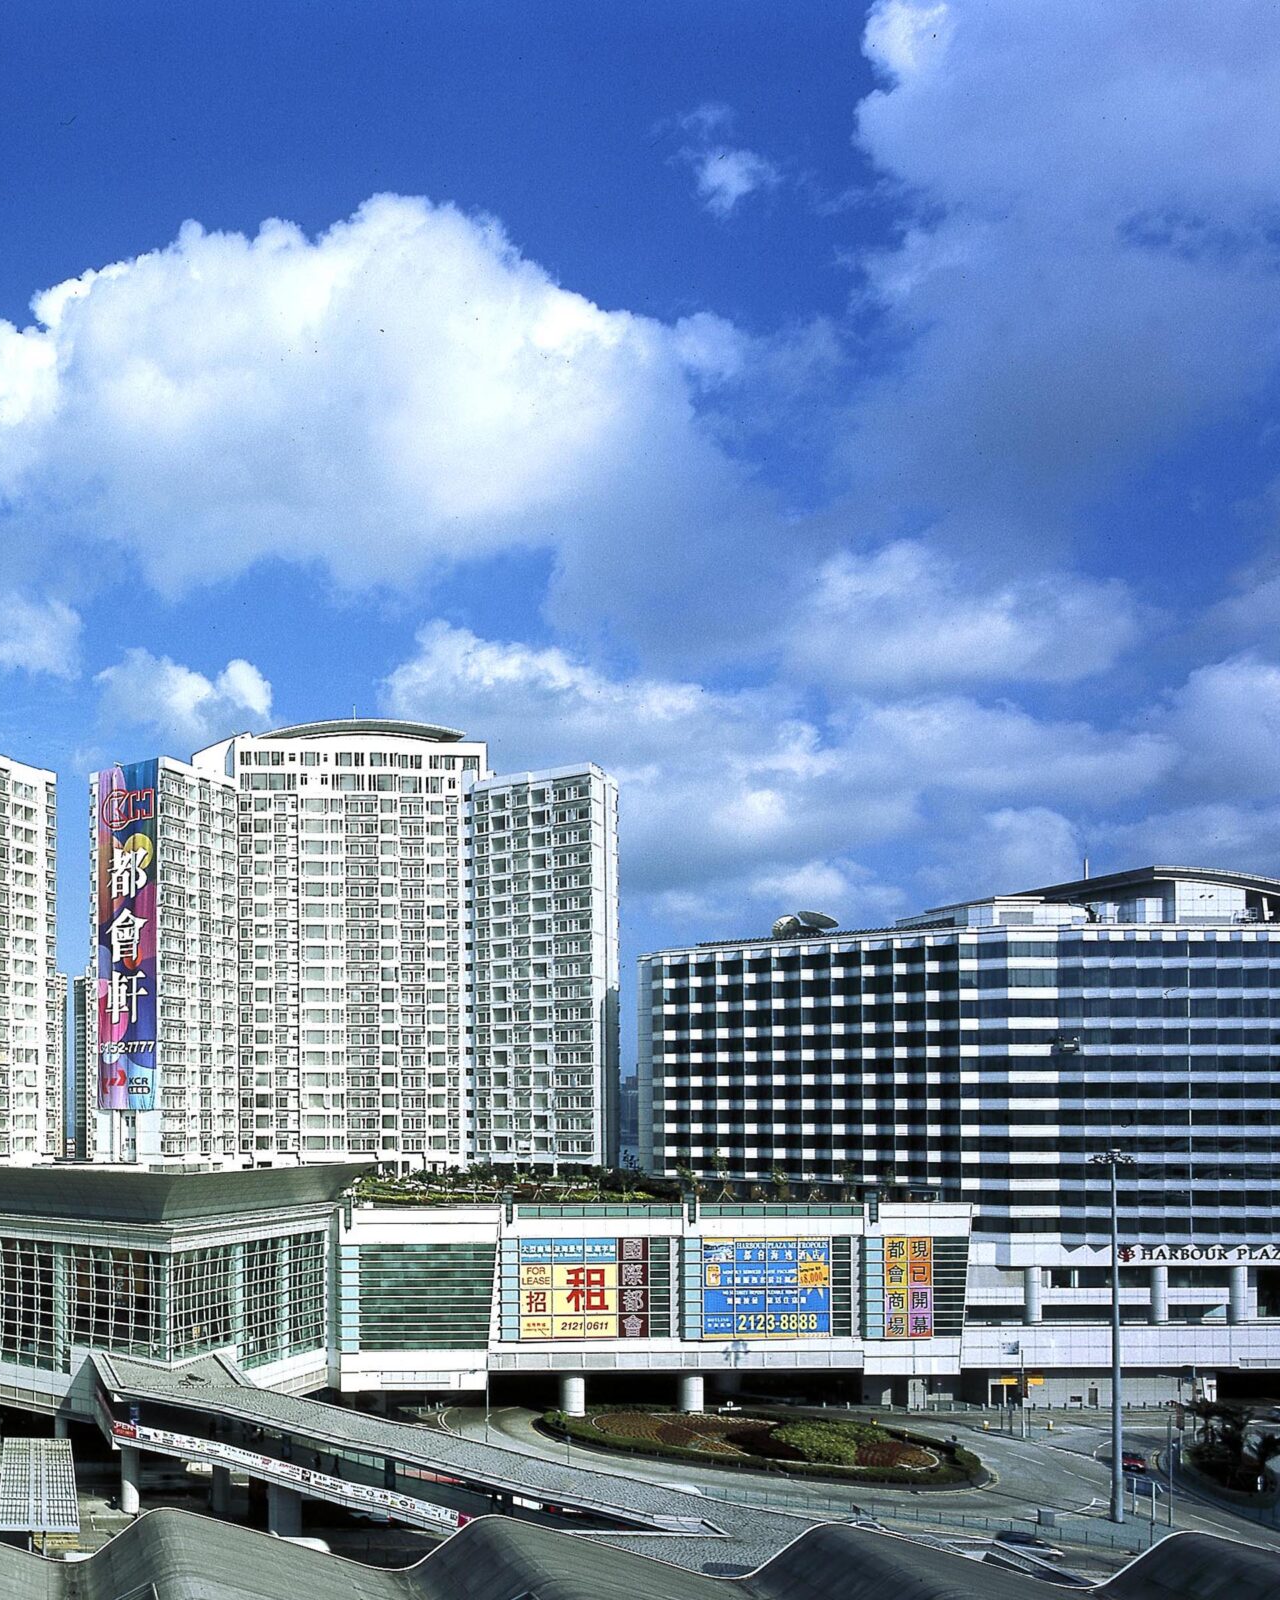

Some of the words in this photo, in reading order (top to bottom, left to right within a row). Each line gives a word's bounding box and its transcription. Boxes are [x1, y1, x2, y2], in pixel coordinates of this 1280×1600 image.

[105, 847, 149, 1024] 都會軒
[1141, 1248, 1228, 1260] HARBOUR
[522, 1277, 550, 1285] LEASE
[888, 1240, 904, 1334] 都會商場
[912, 1240, 928, 1334] 現已開幕
[561, 1322, 583, 1330] 2121
[586, 1322, 608, 1330] 0611
[738, 1314, 818, 1330] 2123-8888
